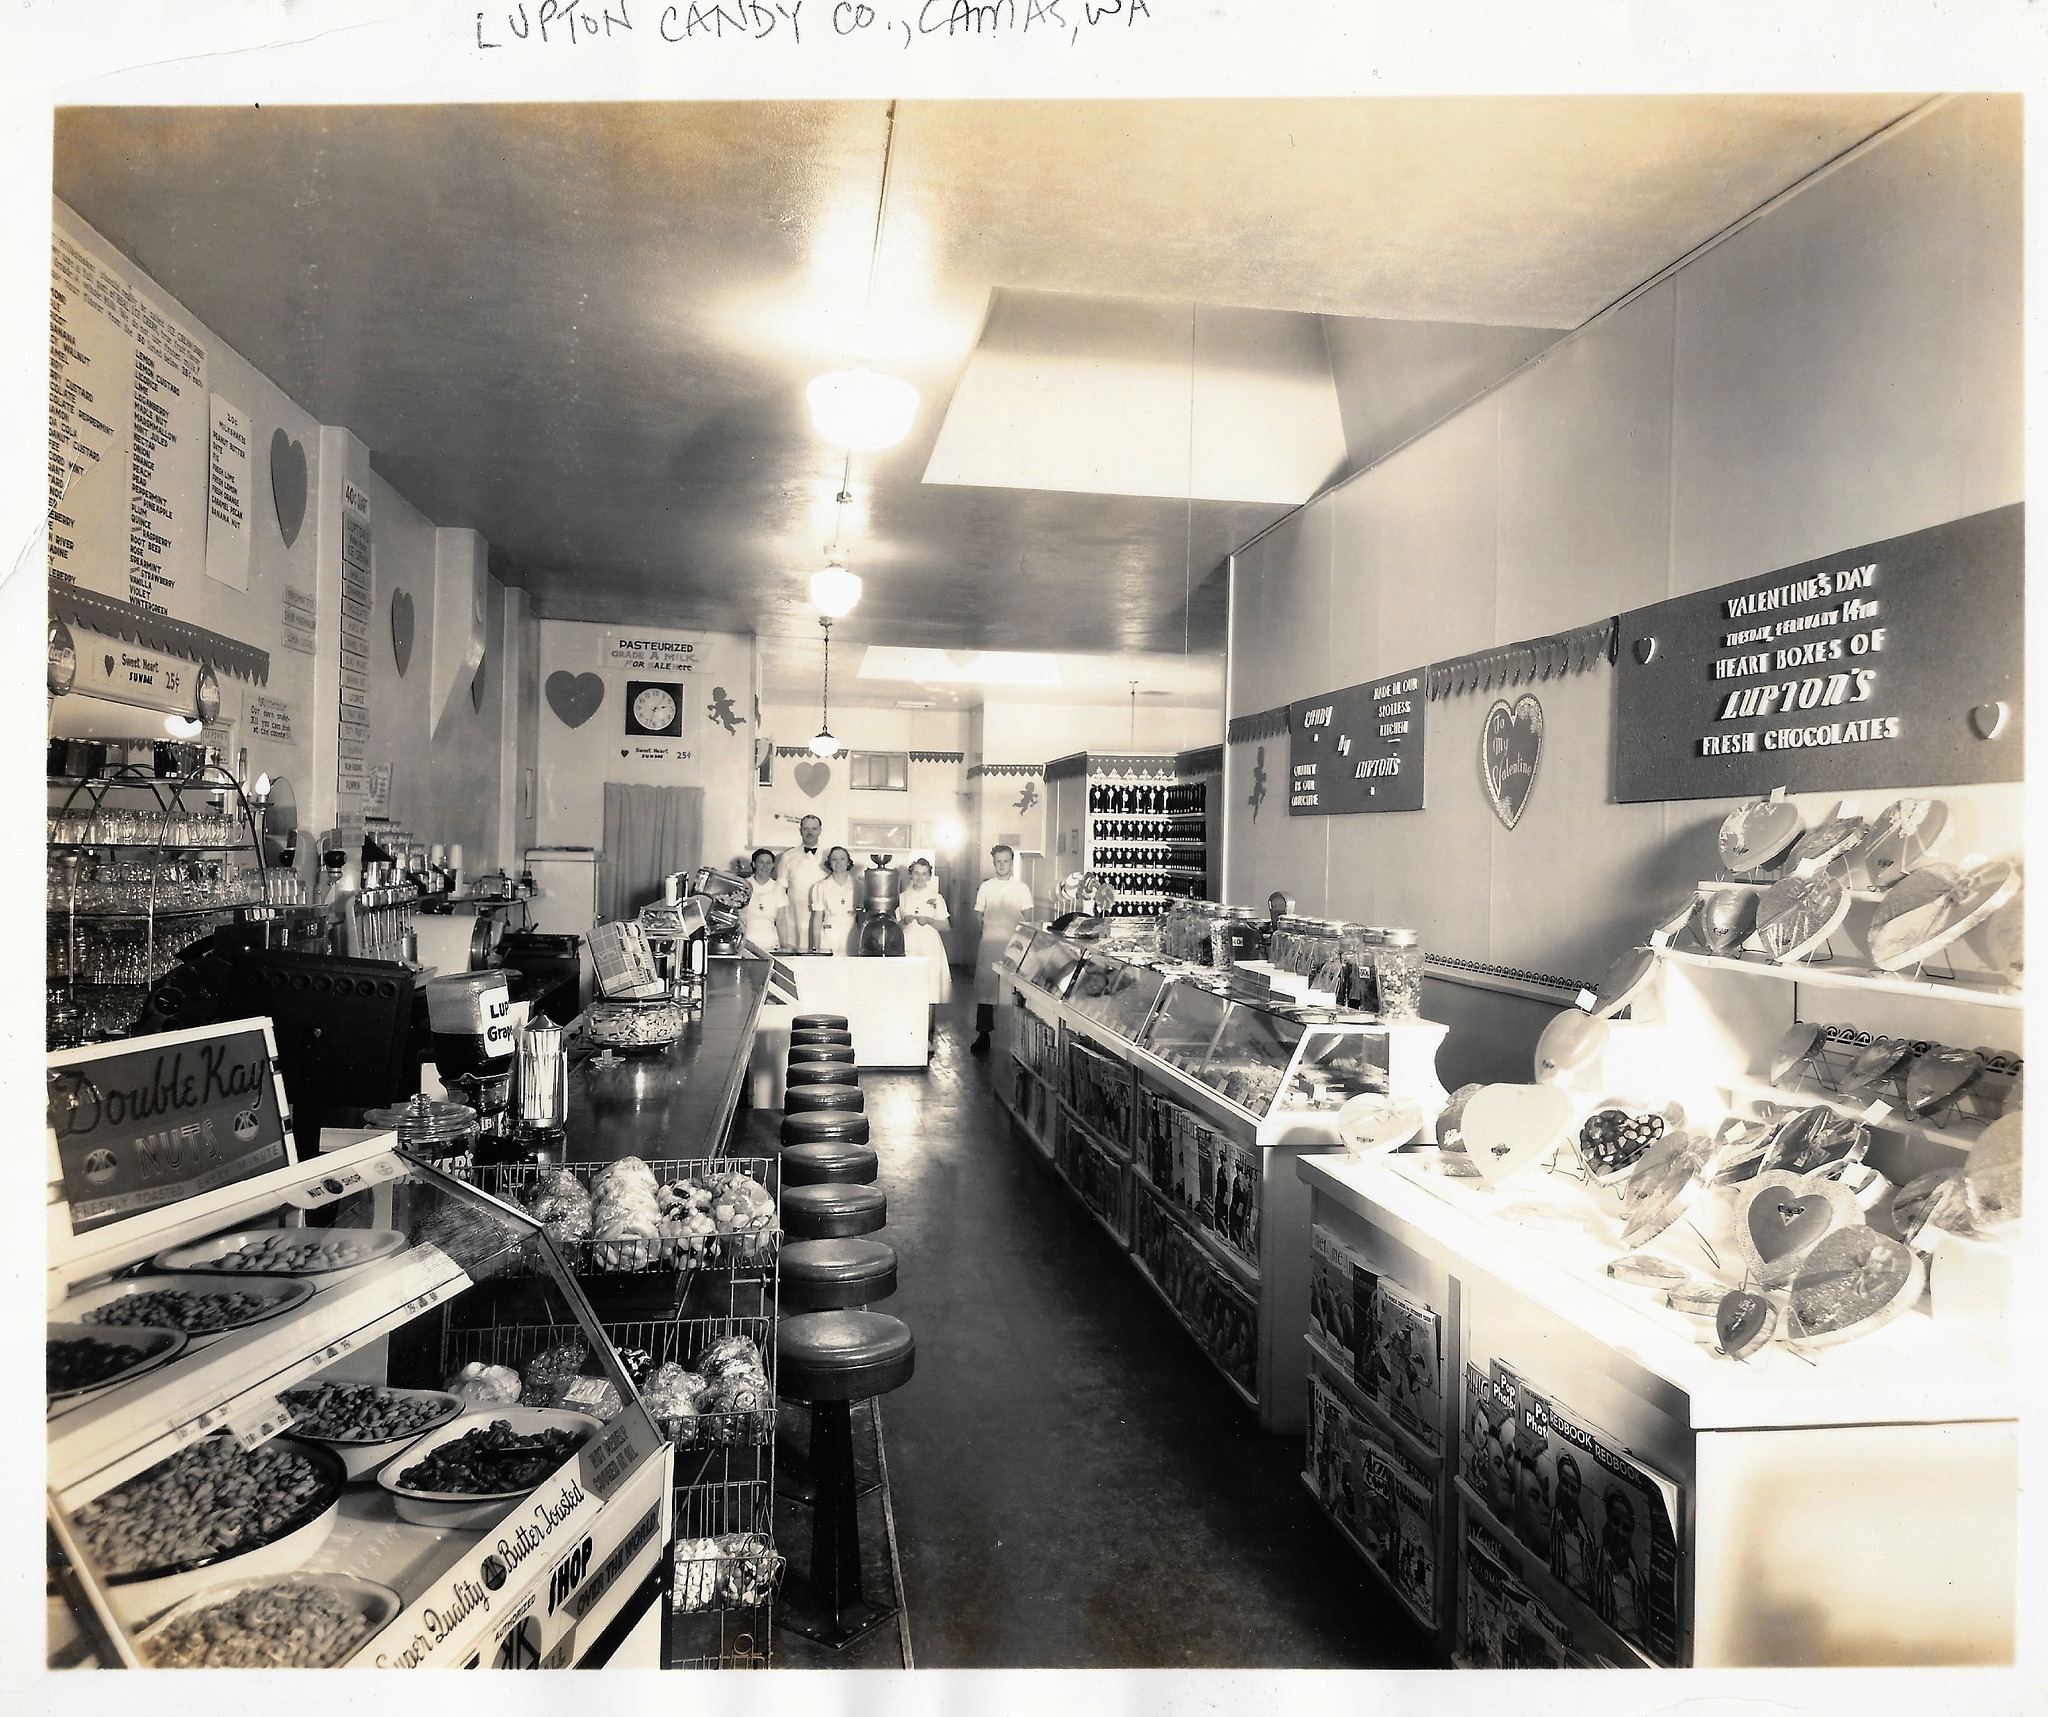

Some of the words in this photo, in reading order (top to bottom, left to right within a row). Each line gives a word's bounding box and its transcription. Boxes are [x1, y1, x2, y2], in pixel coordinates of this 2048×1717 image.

[477, 0, 633, 48] LUPTON
[660, 0, 802, 43] CANDY
[63, 342, 91, 366] WALNUT
[135, 349, 154, 369] LEMON
[135, 360, 154, 379] LEMON
[156, 374, 180, 396] CUSTARD
[135, 369, 159, 392] LICORICE
[135, 379, 149, 396] LIME
[66, 378, 93, 402] CUSTARD
[134, 401, 153, 420] MAPLE
[155, 414, 168, 428] NUT
[135, 391, 169, 419] LOGANBERRY
[61, 423, 77, 438] COLA
[78, 409, 115, 437] PEPPERMINT
[134, 411, 177, 443] MARSHMALLOW
[134, 422, 149, 436] MINT
[219, 420, 246, 446] MILKSHAKES
[73, 440, 101, 462] CUSTARD
[133, 432, 155, 451] NECTAR
[133, 443, 150, 458] ONION
[213, 430, 229, 447] PEANUT
[229, 442, 246, 459] BUTTER
[132, 463, 151, 480] PEACH
[133, 453, 155, 471] ORANGE
[132, 473, 147, 487] PEAR
[212, 463, 224, 475] FRESH
[224, 470, 236, 484] LIME
[212, 473, 224, 487] FRESH
[224, 481, 238, 495] LEMON
[131, 482, 167, 507] PEPPERMINT
[211, 484, 223, 497] FRESH
[223, 491, 240, 507] ORANGE
[131, 503, 147, 518] PLUM
[143, 499, 173, 520] PINEAPPLE
[211, 495, 230, 512] CARAMEL
[230, 505, 243, 520] PECAN
[211, 506, 230, 524] BANANA
[231, 518, 241, 529] NUT
[130, 513, 151, 530] QUINCE
[55, 534, 74, 551] RIVER
[130, 534, 146, 548] ROOT
[148, 541, 162, 554] BEER
[142, 529, 172, 549] RASPBERRY
[130, 544, 144, 557] ROSE
[129, 555, 162, 574] SPEARMINT
[129, 575, 152, 591] VANILLA
[140, 569, 176, 589] STRAWBERRY
[129, 584, 151, 600] VIOLET
[1727, 572, 1831, 618] VALENTINE'S
[1836, 564, 1878, 591] DAY
[129, 595, 168, 616] WINTERGREEN
[1725, 625, 1775, 648] TUESDAY,
[1775, 609, 1840, 637] FEBRUARY
[1842, 598, 1879, 624] 14TH
[611, 650, 644, 659] GRADE
[649, 651, 659, 660] A
[620, 640, 694, 653] PASTEURIZED
[1716, 652, 1769, 680] HEART
[1776, 639, 1842, 670] BOXES
[1850, 628, 1886, 655] OF
[121, 653, 141, 669] Sweet
[142, 658, 160, 674] Heart
[165, 671, 180, 693] 25¢
[624, 660, 645, 668] FOR
[647, 661, 671, 670] SALE
[672, 663, 692, 671] Here
[129, 671, 153, 685] SUNDAE
[1373, 684, 1392, 700] MADE
[1393, 681, 1402, 695] IN
[1403, 678, 1418, 691] OUR
[1721, 667, 1878, 720] LUPTON'S
[250, 705, 261, 715] Our
[1304, 705, 1333, 728] CANDY
[1378, 701, 1411, 718] SPOTLESS
[250, 715, 259, 725] All
[261, 719, 270, 728] you
[271, 722, 281, 731] can
[253, 726, 259, 734] at
[260, 727, 270, 737] the
[1379, 720, 1409, 737] KITCHEN
[1493, 714, 1505, 734] To
[1493, 736, 1508, 757] My
[1702, 732, 1756, 756] FRESH
[1764, 717, 1901, 750] CHOCOLATES
[676, 751, 692, 760] 25¢
[1293, 763, 1317, 778] QUALITY
[1492, 752, 1532, 799] Valentine
[1294, 781, 1302, 792] IS
[1302, 780, 1315, 791] OUR
[1291, 794, 1319, 807] OBJECTIVE
[55, 1053, 199, 1140] Double
[201, 1044, 266, 1110] Kay
[135, 1118, 219, 1179] NUTS
[136, 1185, 186, 1206] TOASTED
[239, 1146, 280, 1170] MINUTE
[308, 1186, 326, 1198] NUT
[342, 1173, 362, 1187] SHOP
[588, 1445, 606, 1469] NOT
[1595, 1444, 1641, 1483] REDBOOK
[593, 1461, 621, 1493] COOKED
[616, 1452, 629, 1471] IN
[624, 1443, 639, 1463] OIL
[424, 1580, 490, 1644] Quality
[497, 1524, 546, 1575] Butter
[535, 1478, 585, 1536] Toasted
[577, 1572, 604, 1617] OVER
[606, 1548, 624, 1583] THE
[624, 1512, 656, 1560] WORLD
[494, 1594, 537, 1643] AUTHORIZED
